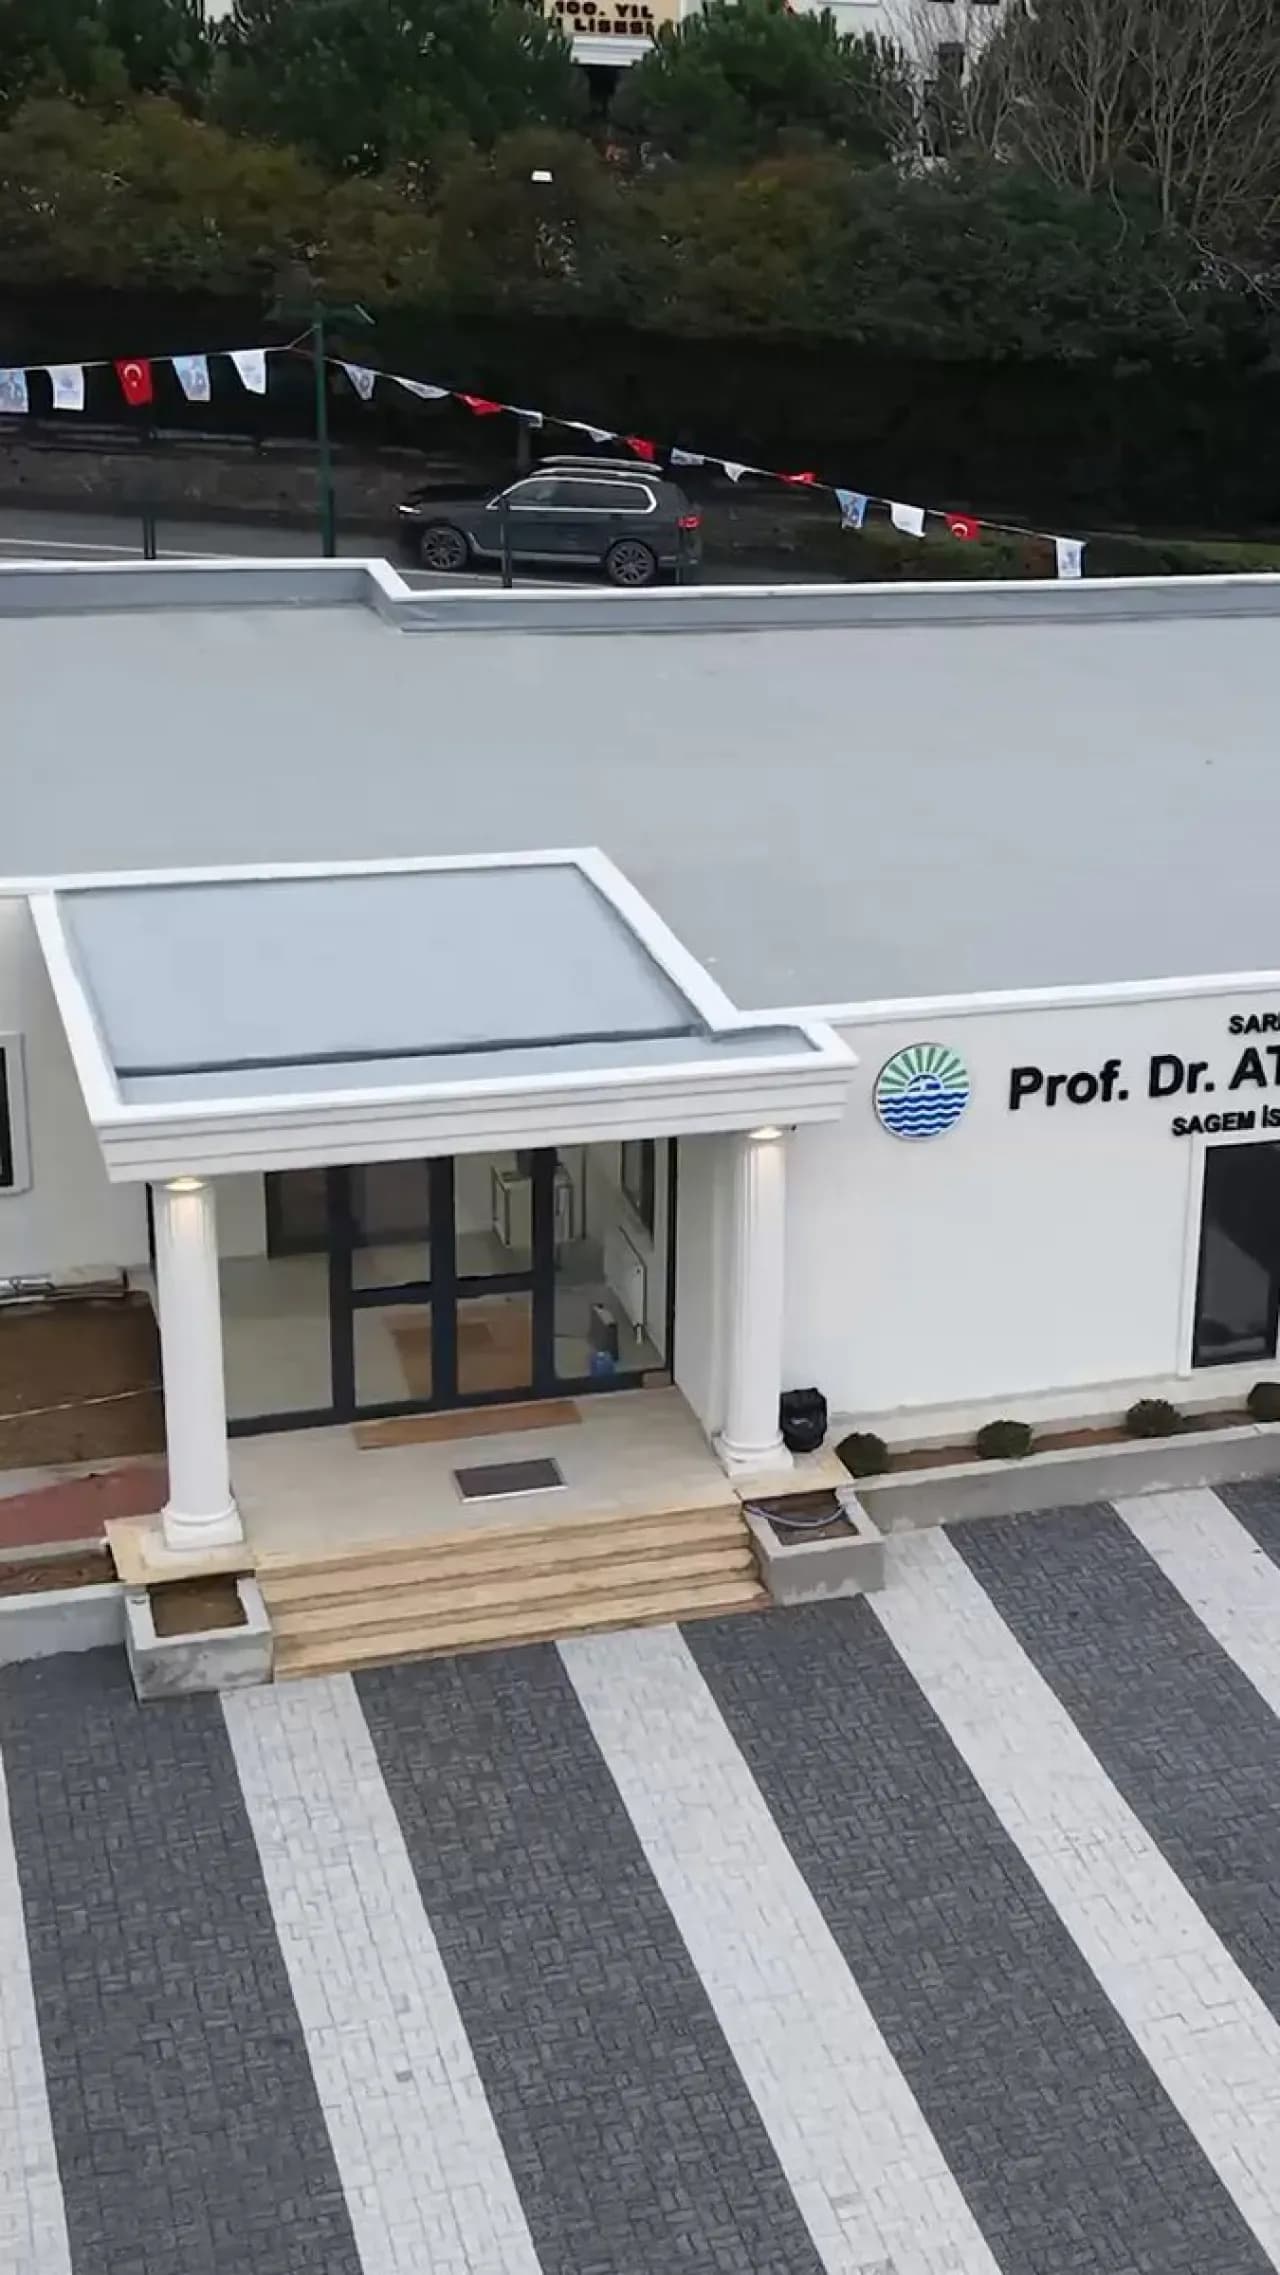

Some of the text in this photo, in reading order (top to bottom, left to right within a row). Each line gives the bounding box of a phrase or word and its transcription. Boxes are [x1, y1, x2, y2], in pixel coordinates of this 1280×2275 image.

[615, 4, 654, 19] YIL
[1008, 1060, 1128, 1110] Prof.
[1148, 1054, 1214, 1097] Dr.
[1171, 1110, 1254, 1136] SAGEM
